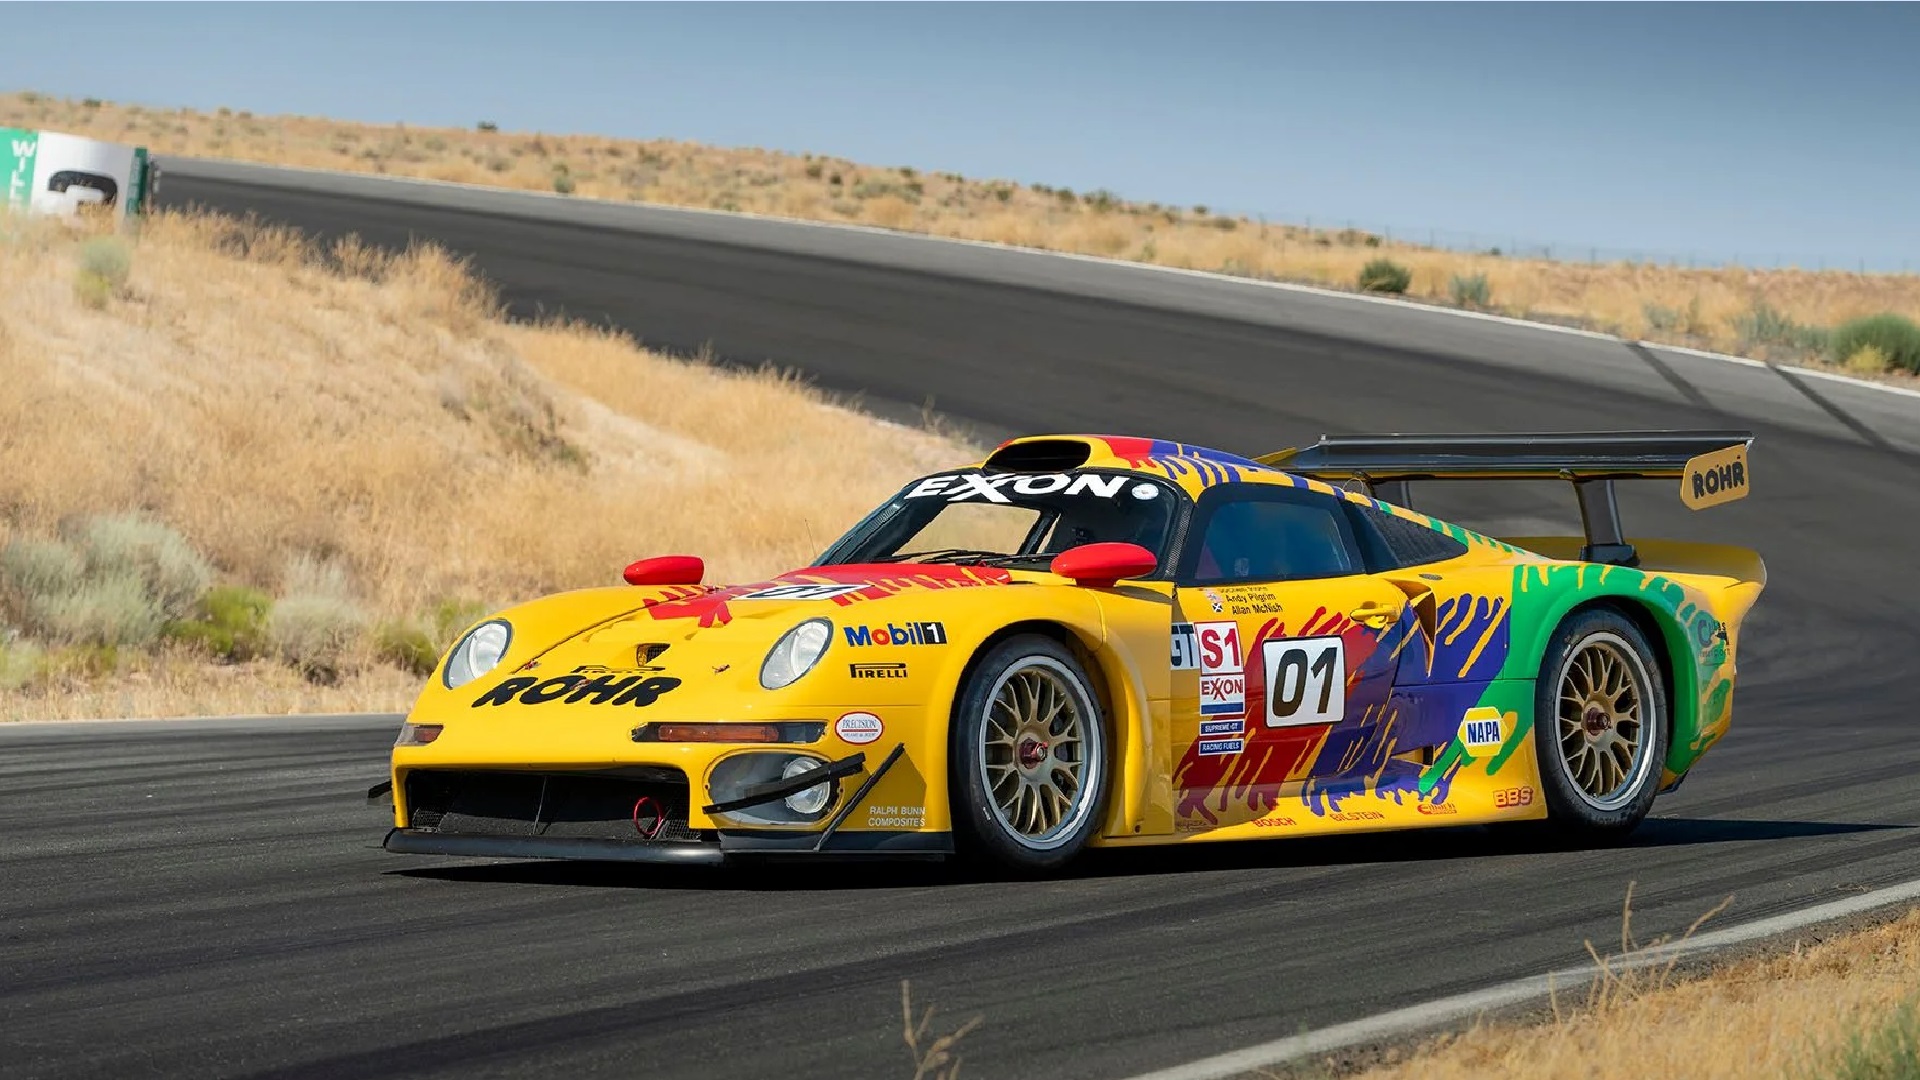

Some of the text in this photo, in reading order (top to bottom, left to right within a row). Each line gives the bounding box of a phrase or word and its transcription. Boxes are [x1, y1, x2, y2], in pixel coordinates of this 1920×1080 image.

[1692, 461, 1745, 499] ROHR
[904, 473, 1130, 503] EXXON
[1226, 592, 1276, 603] Andy Pilgrim
[1232, 603, 1283, 614] Allan McNish
[1201, 628, 1241, 668] S1
[849, 663, 907, 678] PIRELLI
[1201, 678, 1244, 701] EXXON
[1272, 647, 1338, 717] 01
[471, 675, 682, 707] ROHR
[842, 719, 876, 729] PRECISION
[1467, 721, 1500, 743] NAPA
[1202, 742, 1239, 751] RACING FUELS
[1493, 786, 1534, 808] BBS
[870, 806, 926, 815] RALPH BUNN
[1330, 811, 1385, 822] BILSTEIN
[868, 817, 926, 827] COMPOSITES
[1252, 817, 1297, 828] BOSCH
